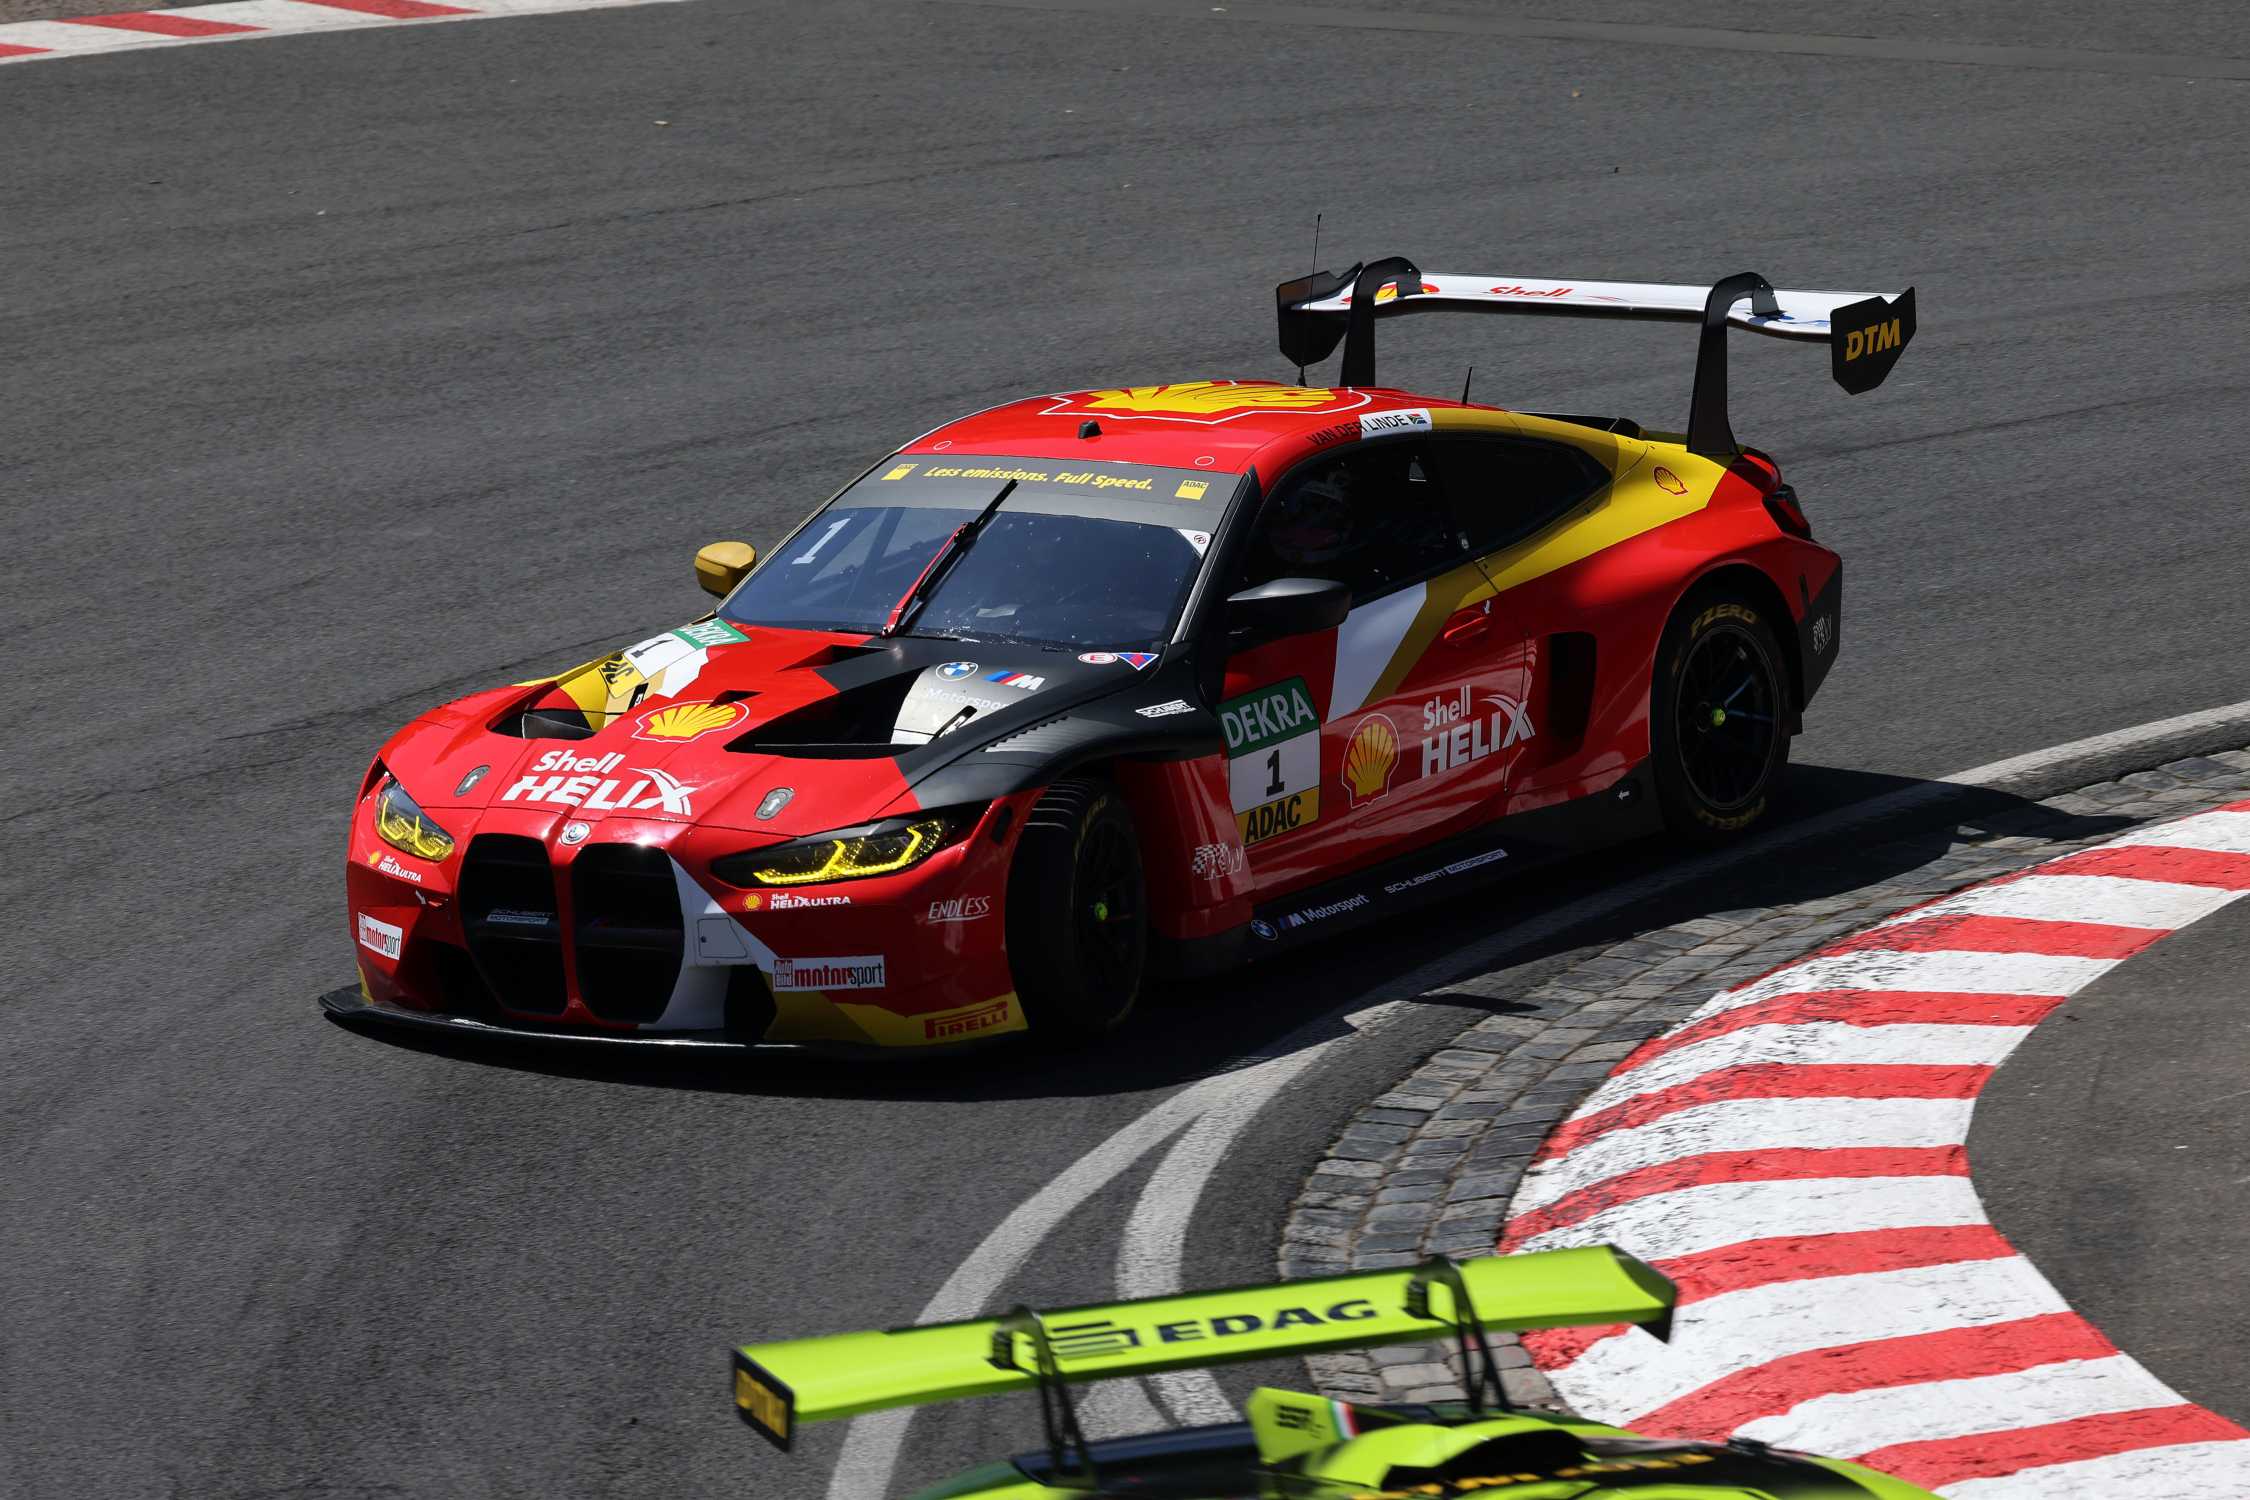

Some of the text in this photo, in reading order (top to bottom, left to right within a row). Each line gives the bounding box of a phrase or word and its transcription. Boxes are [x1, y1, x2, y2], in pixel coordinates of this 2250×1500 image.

[1489, 285, 1575, 298] Shell
[1844, 318, 1901, 362] DTM
[1306, 414, 1409, 445] VAN DER LINDE
[922, 466, 1153, 490] Less emissions. Full Speed.
[791, 517, 851, 565] 1
[926, 687, 1010, 711] Motorspor
[1423, 684, 1471, 732] Shell
[1221, 686, 1315, 749] DEKRA
[1421, 693, 1537, 779] HELIX
[530, 749, 626, 775] Shell
[1265, 749, 1286, 798] 1
[500, 767, 700, 817] HELIX
[1244, 795, 1302, 845] ADAC
[770, 893, 790, 901] Shell
[770, 895, 852, 910] HELIX ULTRA
[927, 895, 992, 921] ENDLESS
[1302, 893, 1371, 923] Motorsport
[794, 963, 884, 987] motorsport
[923, 1001, 1009, 1040] PIRELLI
[1154, 1299, 1379, 1344] EDAG
